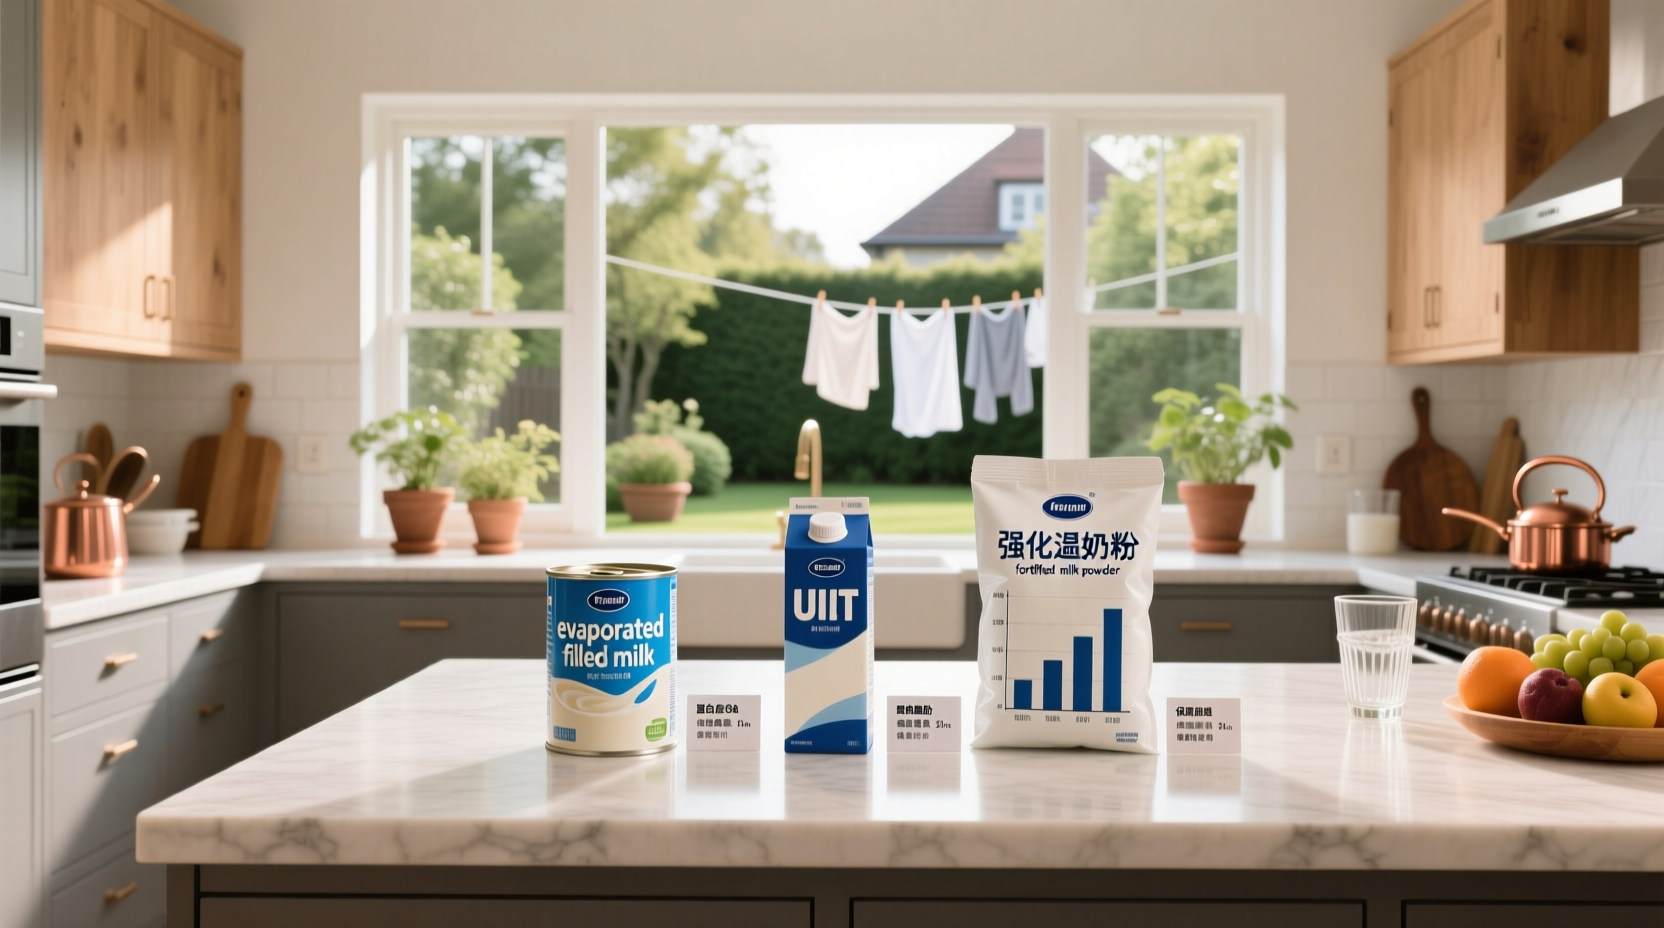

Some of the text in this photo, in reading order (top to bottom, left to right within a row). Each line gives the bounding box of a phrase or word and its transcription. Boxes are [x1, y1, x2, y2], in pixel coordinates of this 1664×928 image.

[1082, 563, 1120, 577] powder
[557, 612, 664, 647] evaporated
[562, 642, 655, 668] filled milk
